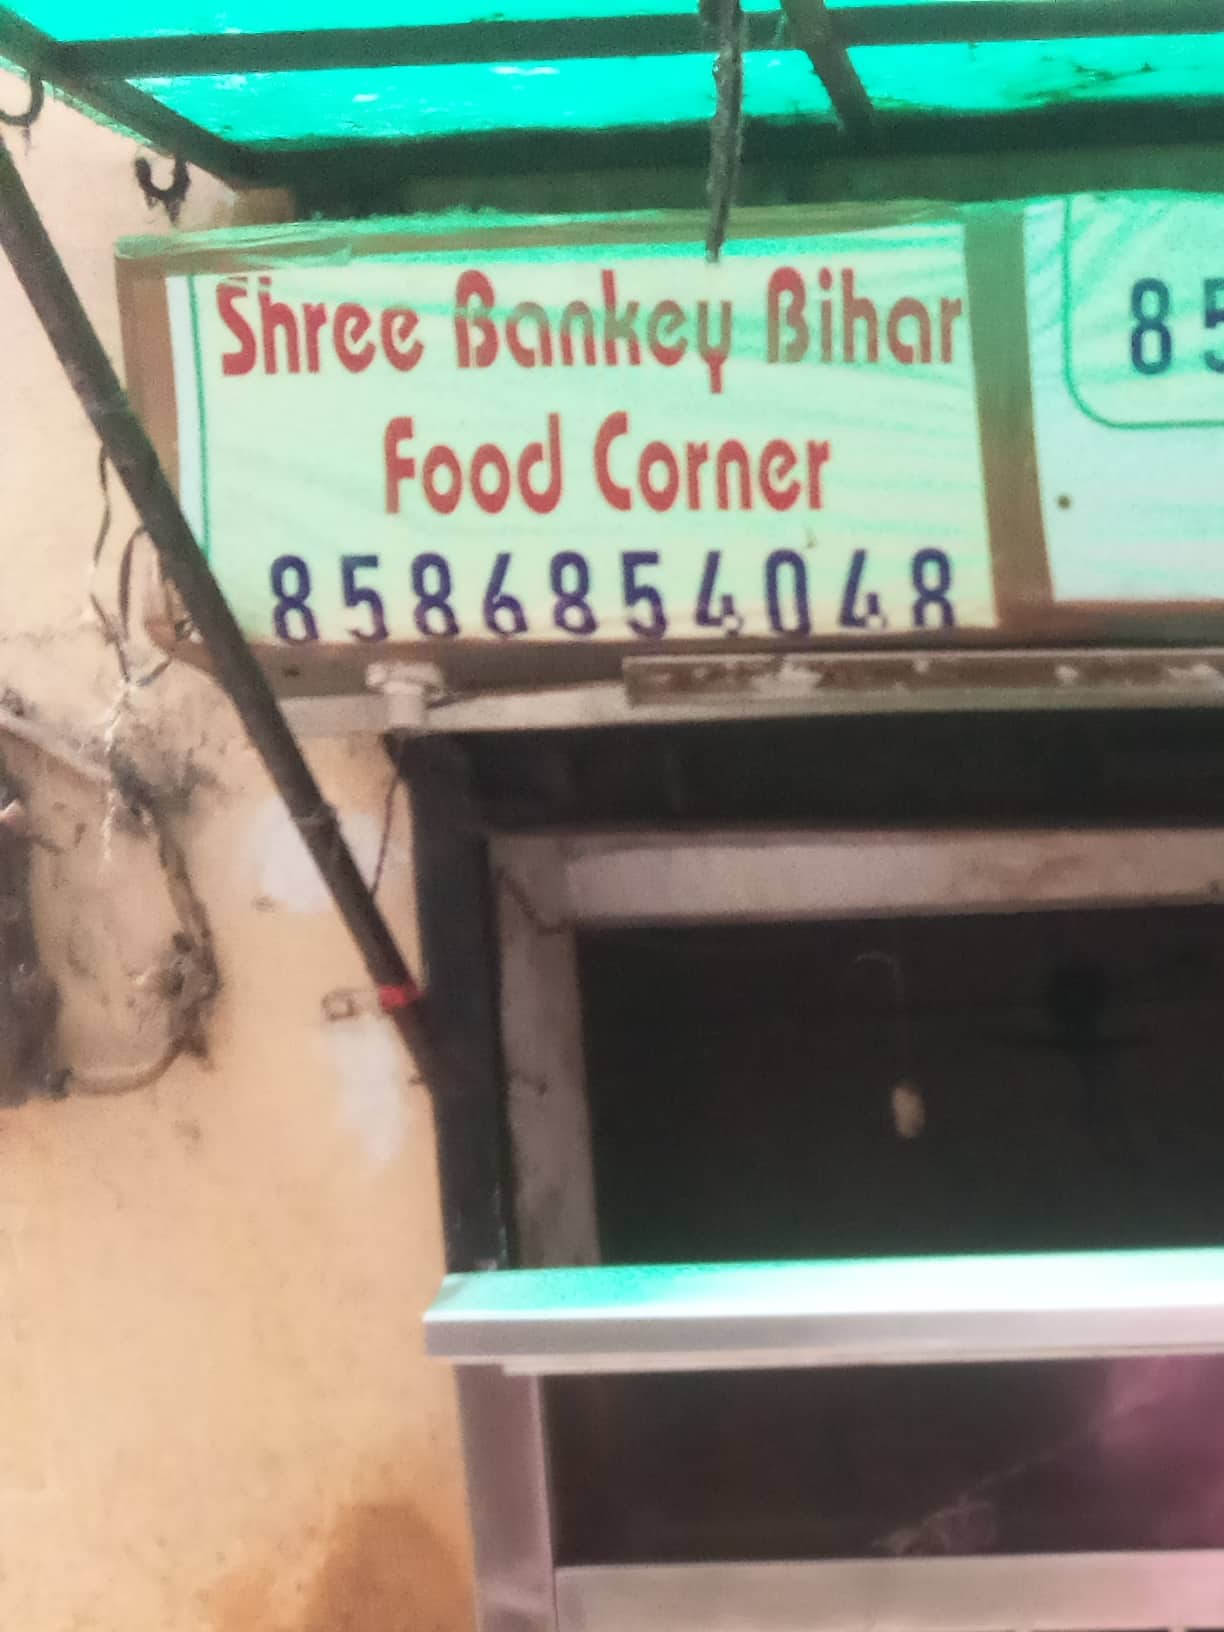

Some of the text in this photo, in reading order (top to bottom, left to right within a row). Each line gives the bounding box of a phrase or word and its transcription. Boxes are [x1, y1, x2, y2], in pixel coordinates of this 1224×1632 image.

[215, 265, 963, 394] Shree Bankey Bihar
[383, 410, 833, 515] Food Corner
[269, 547, 956, 645] 8586854048
